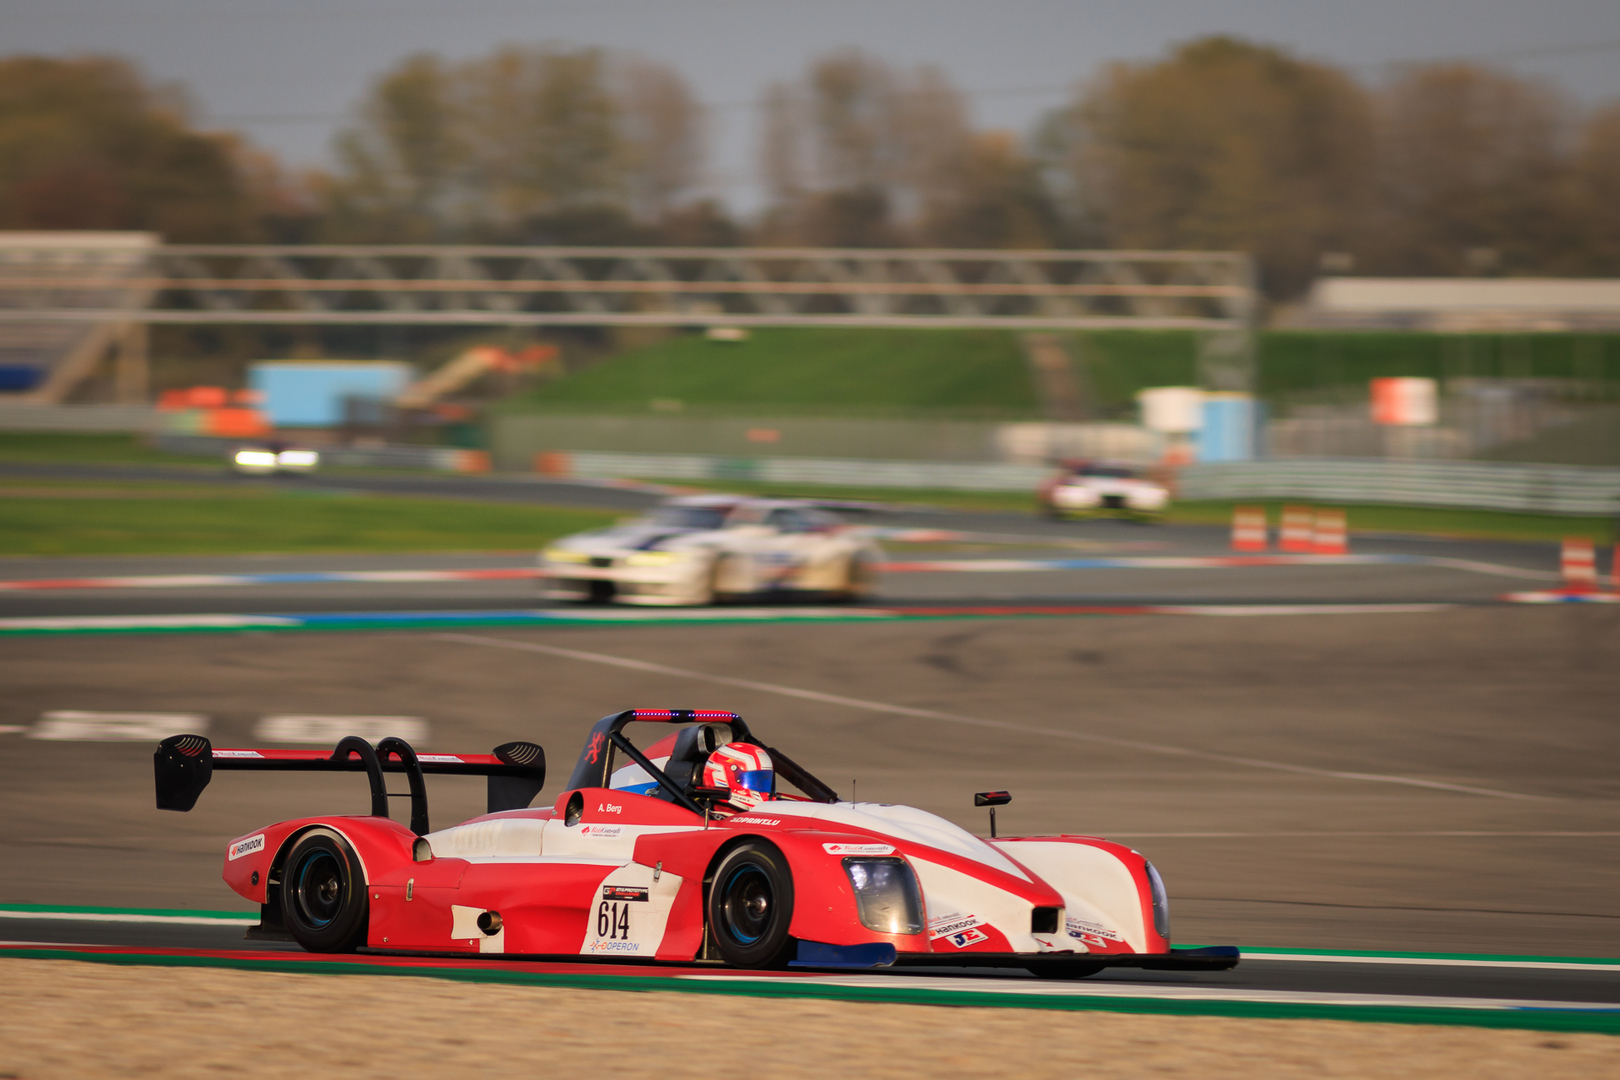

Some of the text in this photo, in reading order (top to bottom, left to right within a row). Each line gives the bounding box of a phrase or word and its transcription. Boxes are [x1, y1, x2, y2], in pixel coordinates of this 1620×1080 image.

[598, 803, 622, 814] A. Berg
[598, 901, 630, 940] 614
